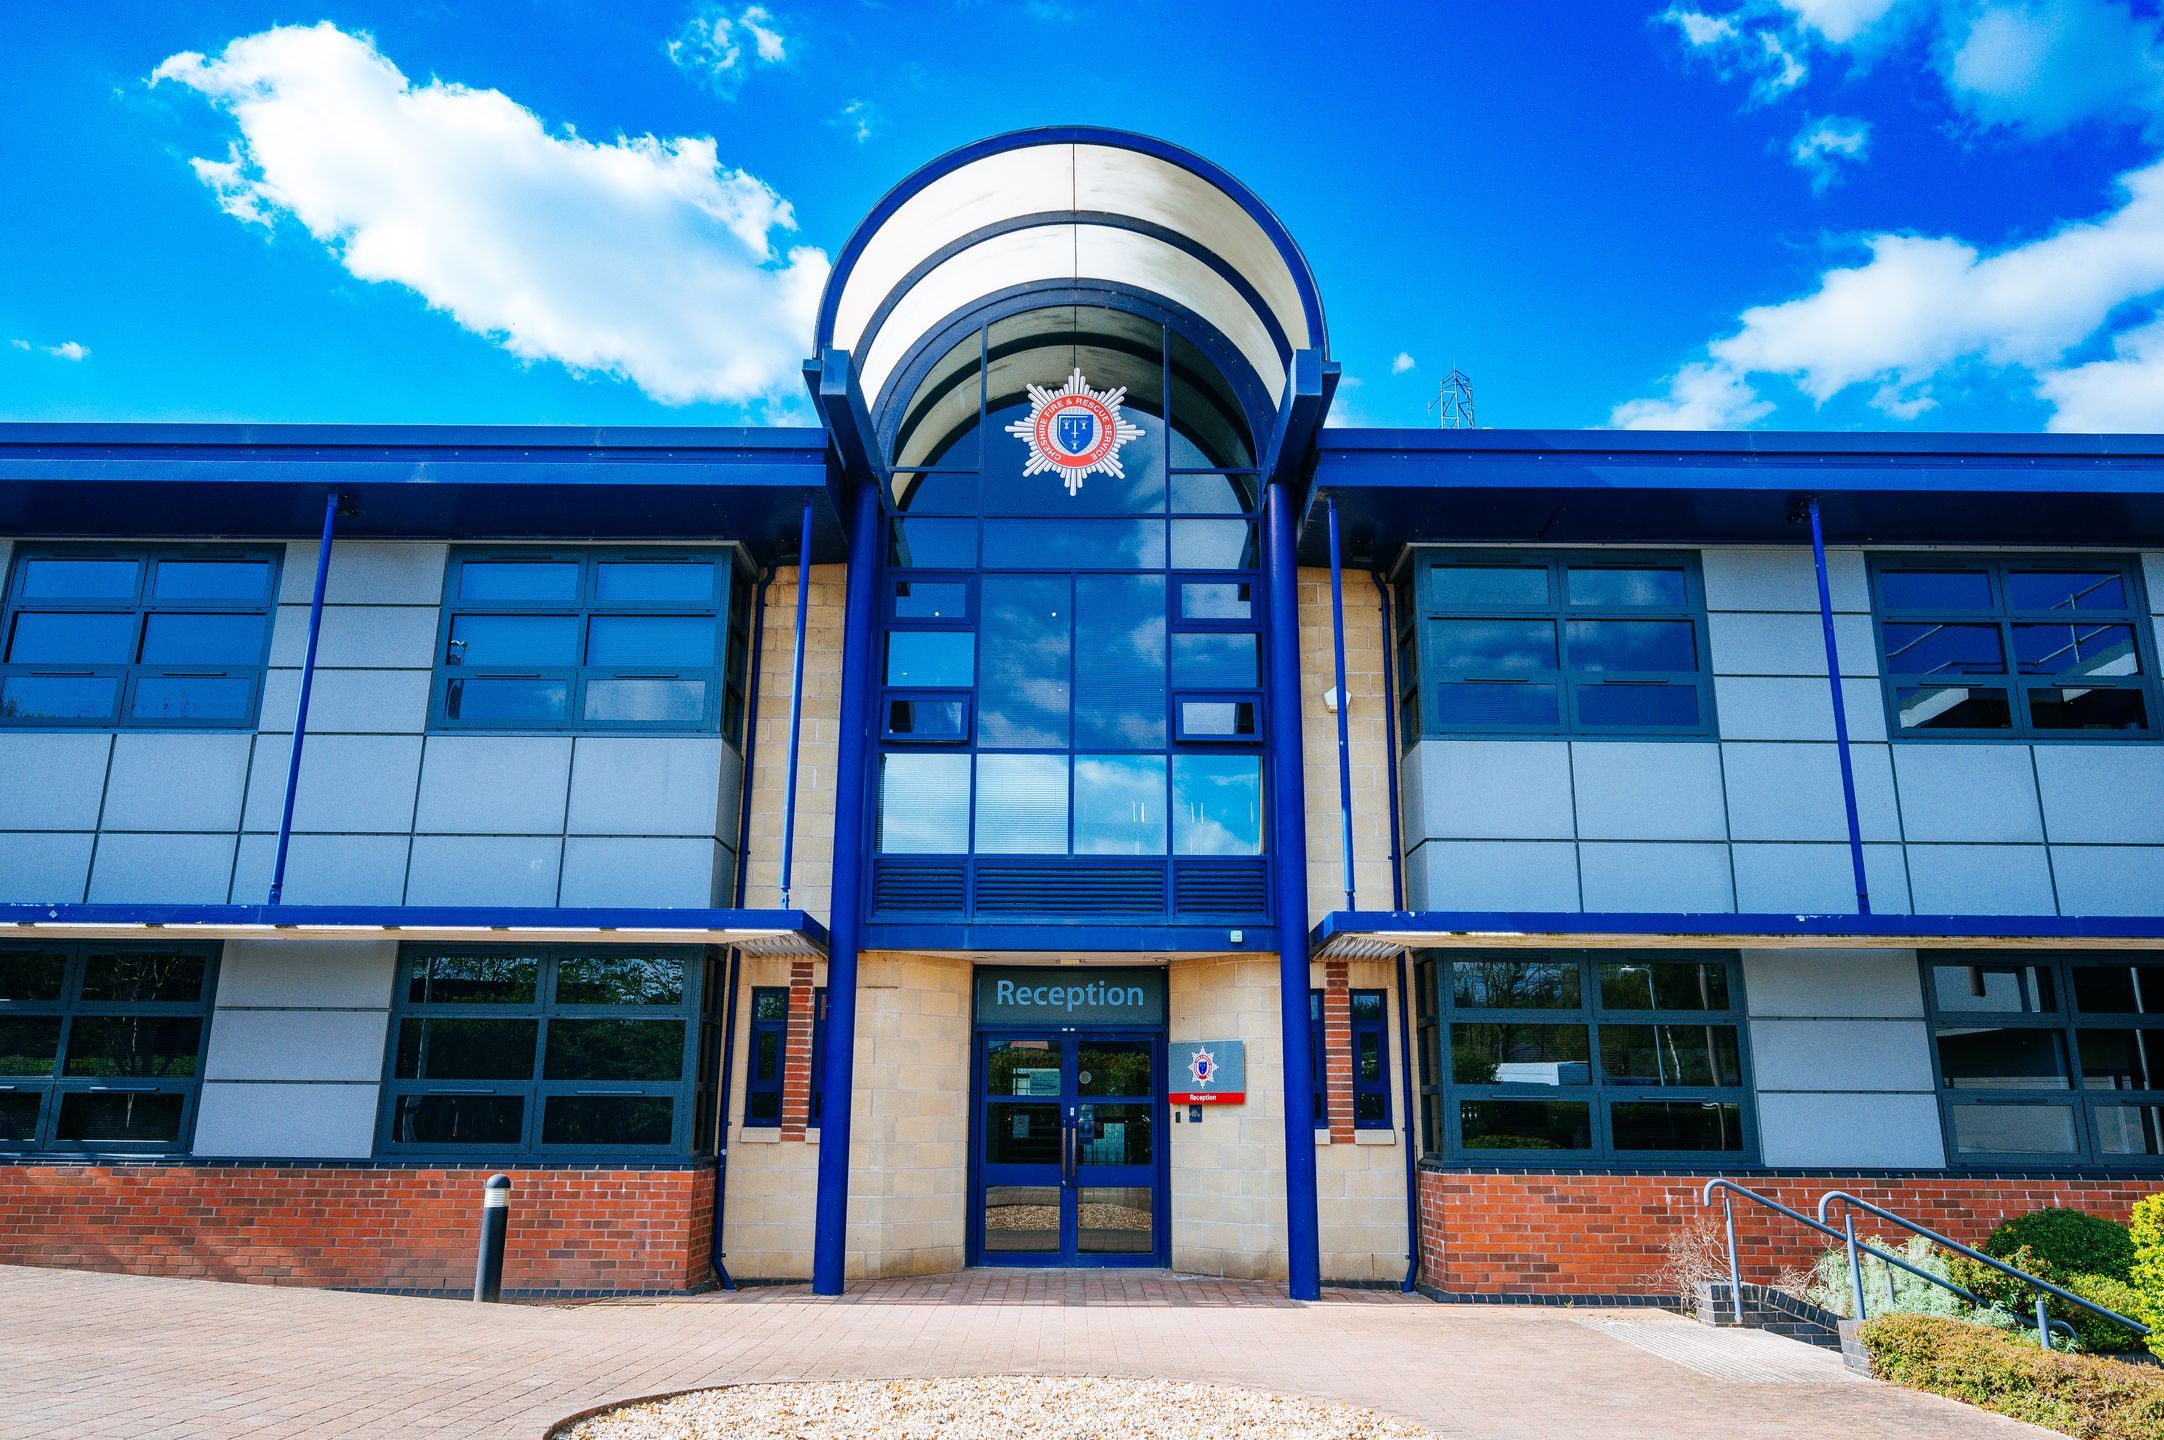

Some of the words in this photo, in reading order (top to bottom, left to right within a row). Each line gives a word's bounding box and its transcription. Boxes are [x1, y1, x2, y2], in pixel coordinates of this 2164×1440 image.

[1044, 401, 1064, 417] FIRE
[1075, 397, 1110, 423] RESCUE
[1038, 418, 1062, 461] CHESHIRE
[1090, 424, 1112, 461] SERVICE
[996, 980, 1145, 1012] Reception
[1189, 1094, 1217, 1102] Reception
